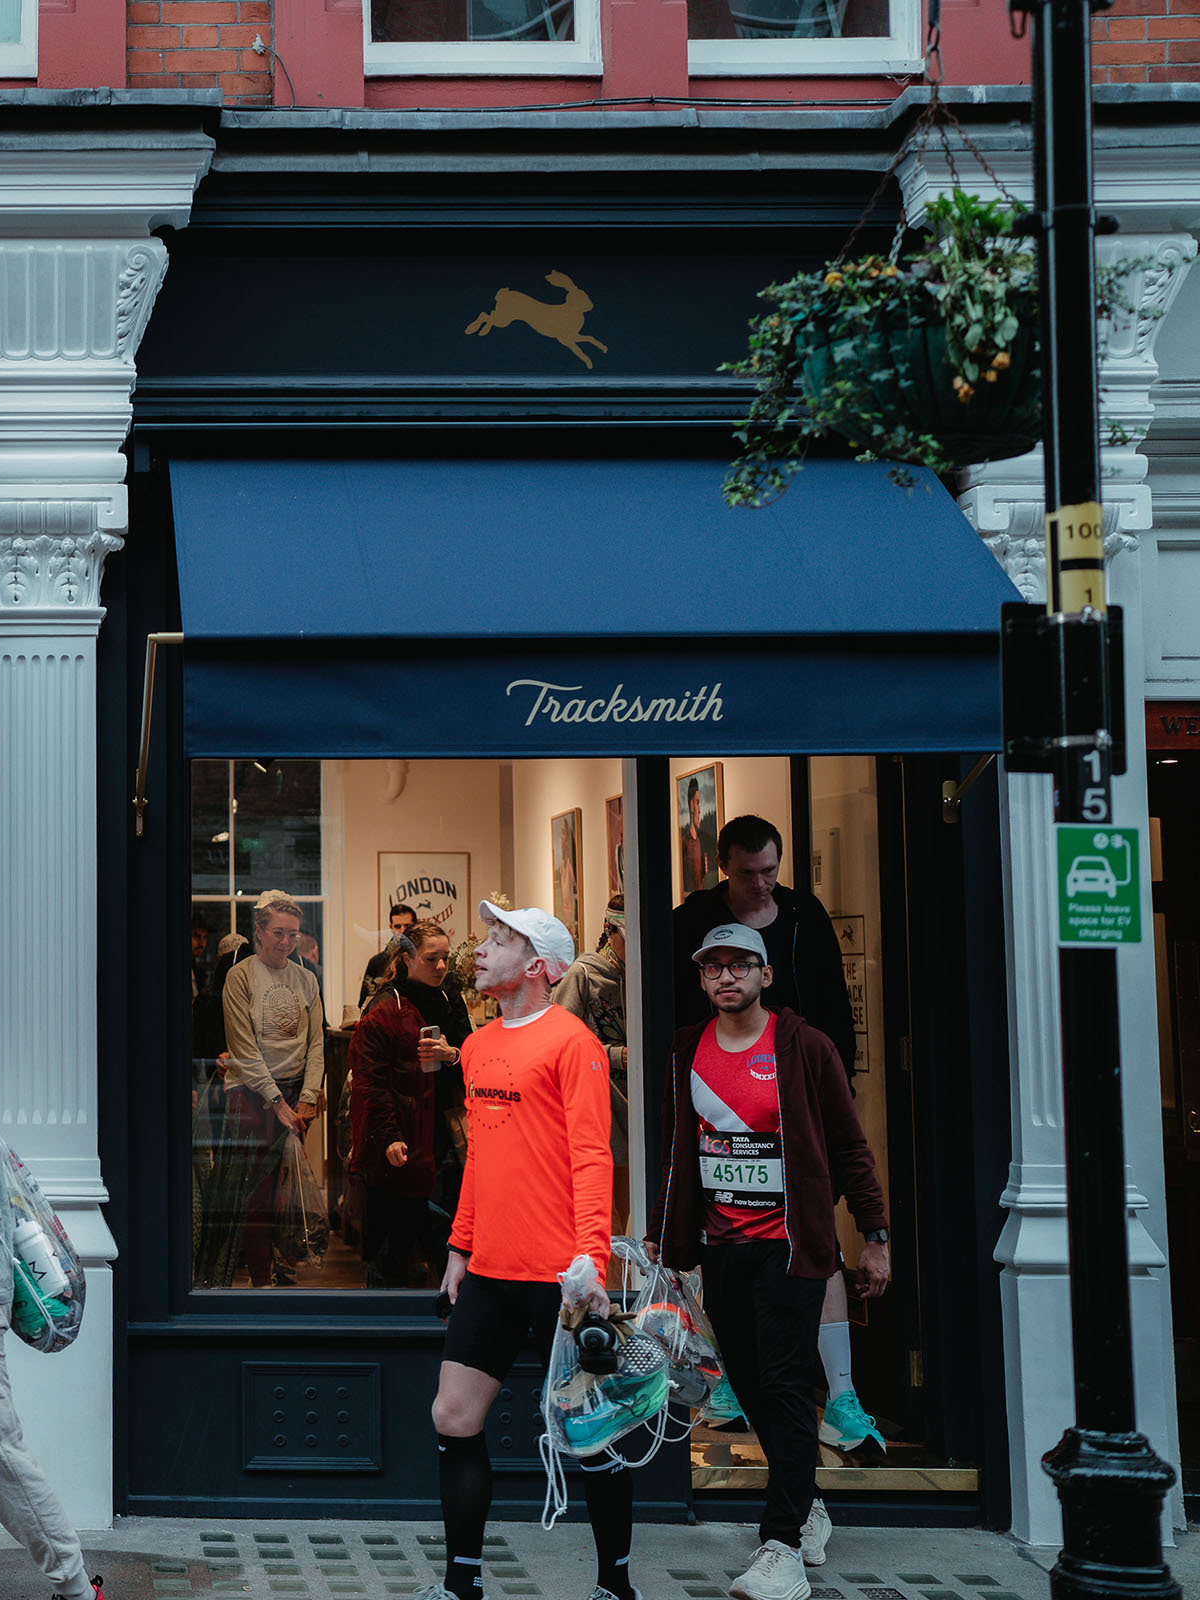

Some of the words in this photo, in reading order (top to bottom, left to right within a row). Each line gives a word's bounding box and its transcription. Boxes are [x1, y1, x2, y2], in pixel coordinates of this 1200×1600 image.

[1066, 522, 1103, 539] 100
[506, 679, 723, 727] Tracksmith
[848, 984, 864, 1003] ACK
[713, 1163, 768, 1184] 45175
